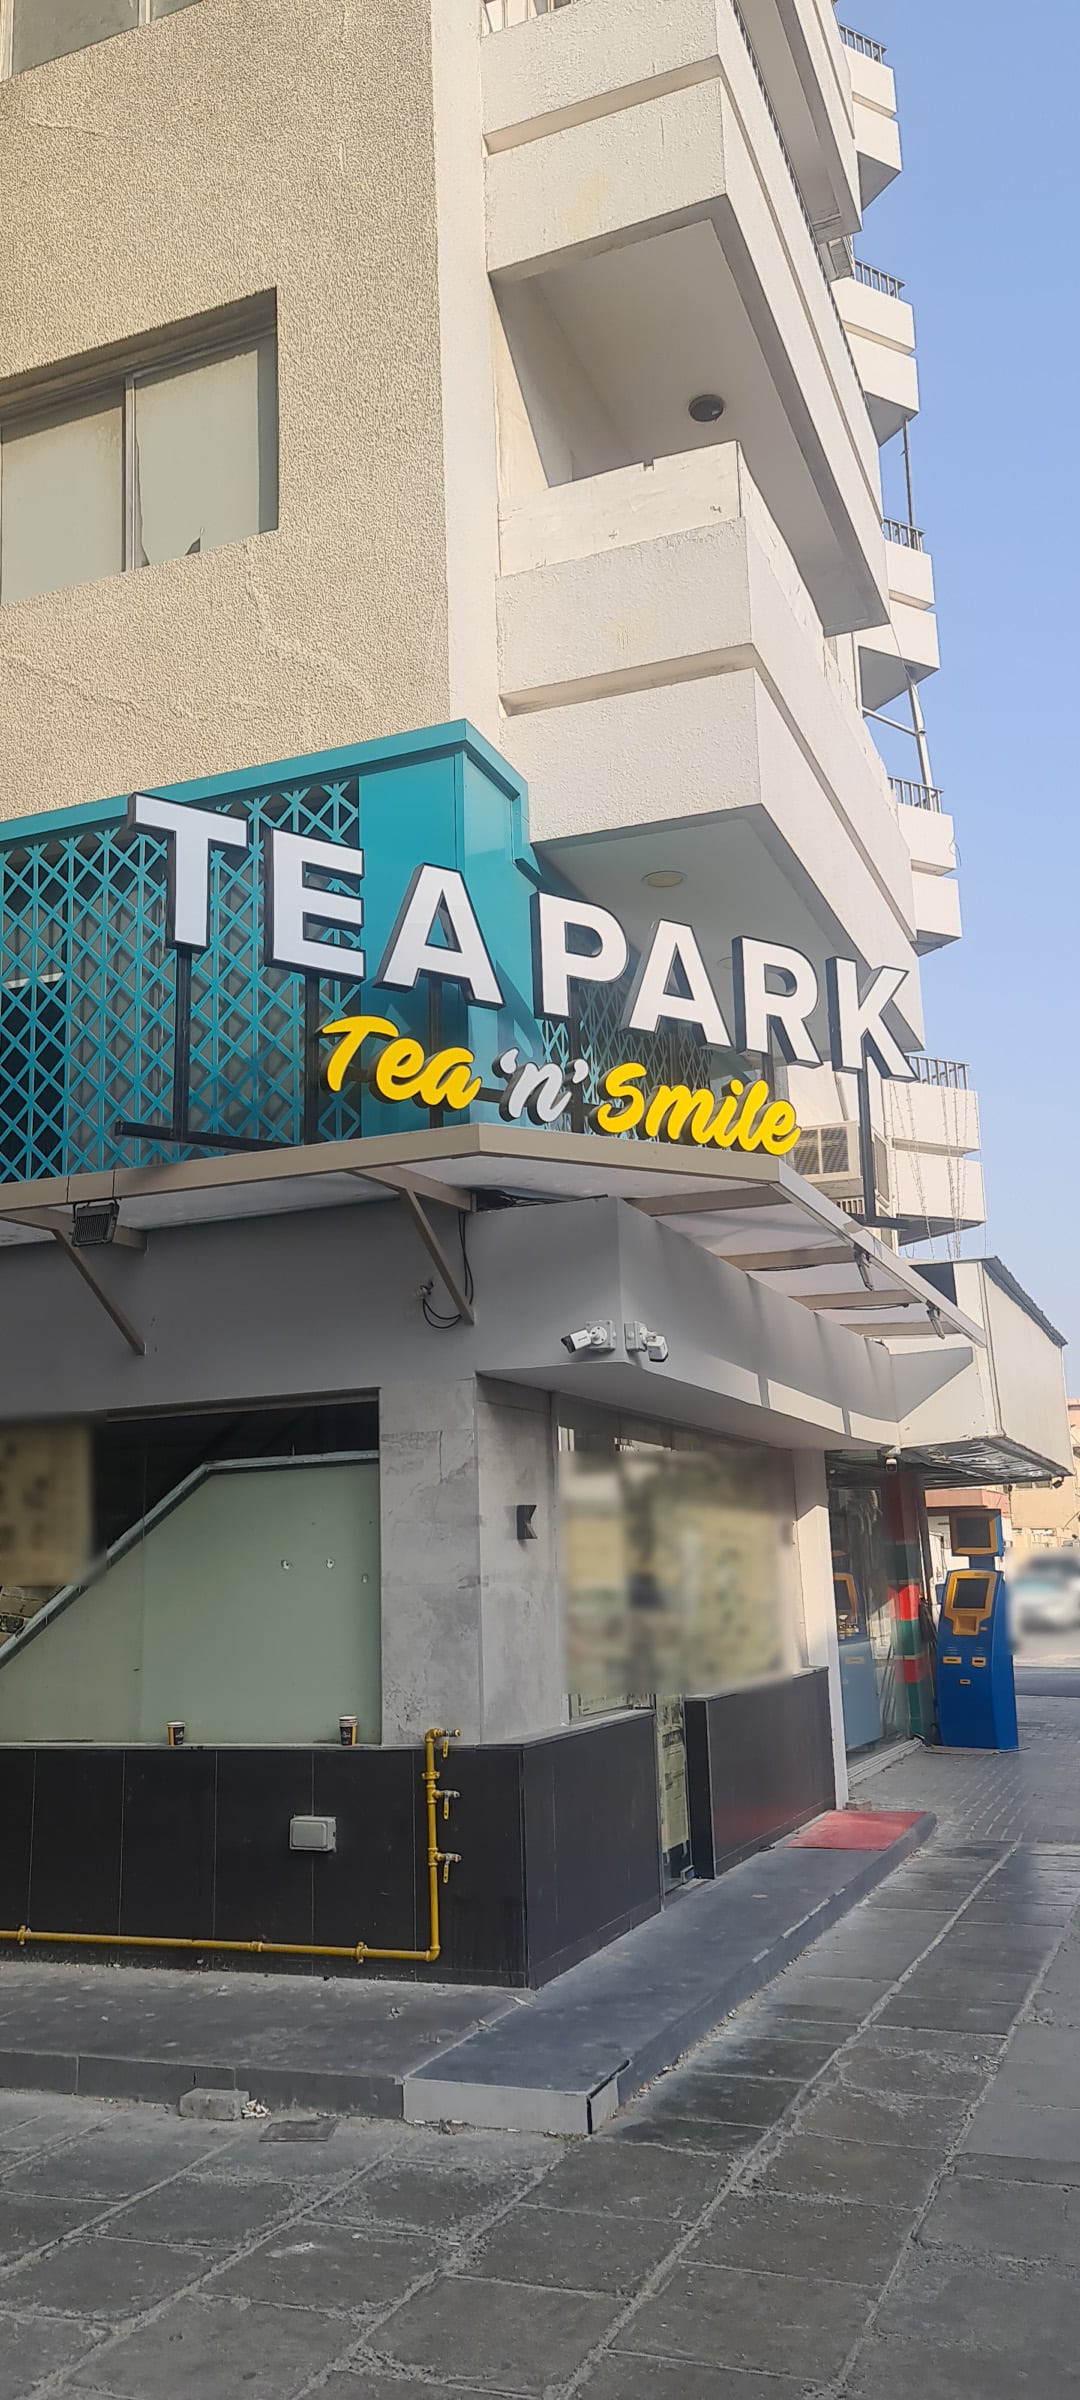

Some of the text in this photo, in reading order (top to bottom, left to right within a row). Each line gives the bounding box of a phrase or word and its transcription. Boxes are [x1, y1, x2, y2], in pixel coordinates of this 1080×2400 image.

[129, 793, 917, 1081] TEA PARK
[320, 1014, 482, 1111] Tea
[596, 1061, 802, 1157] Smile
